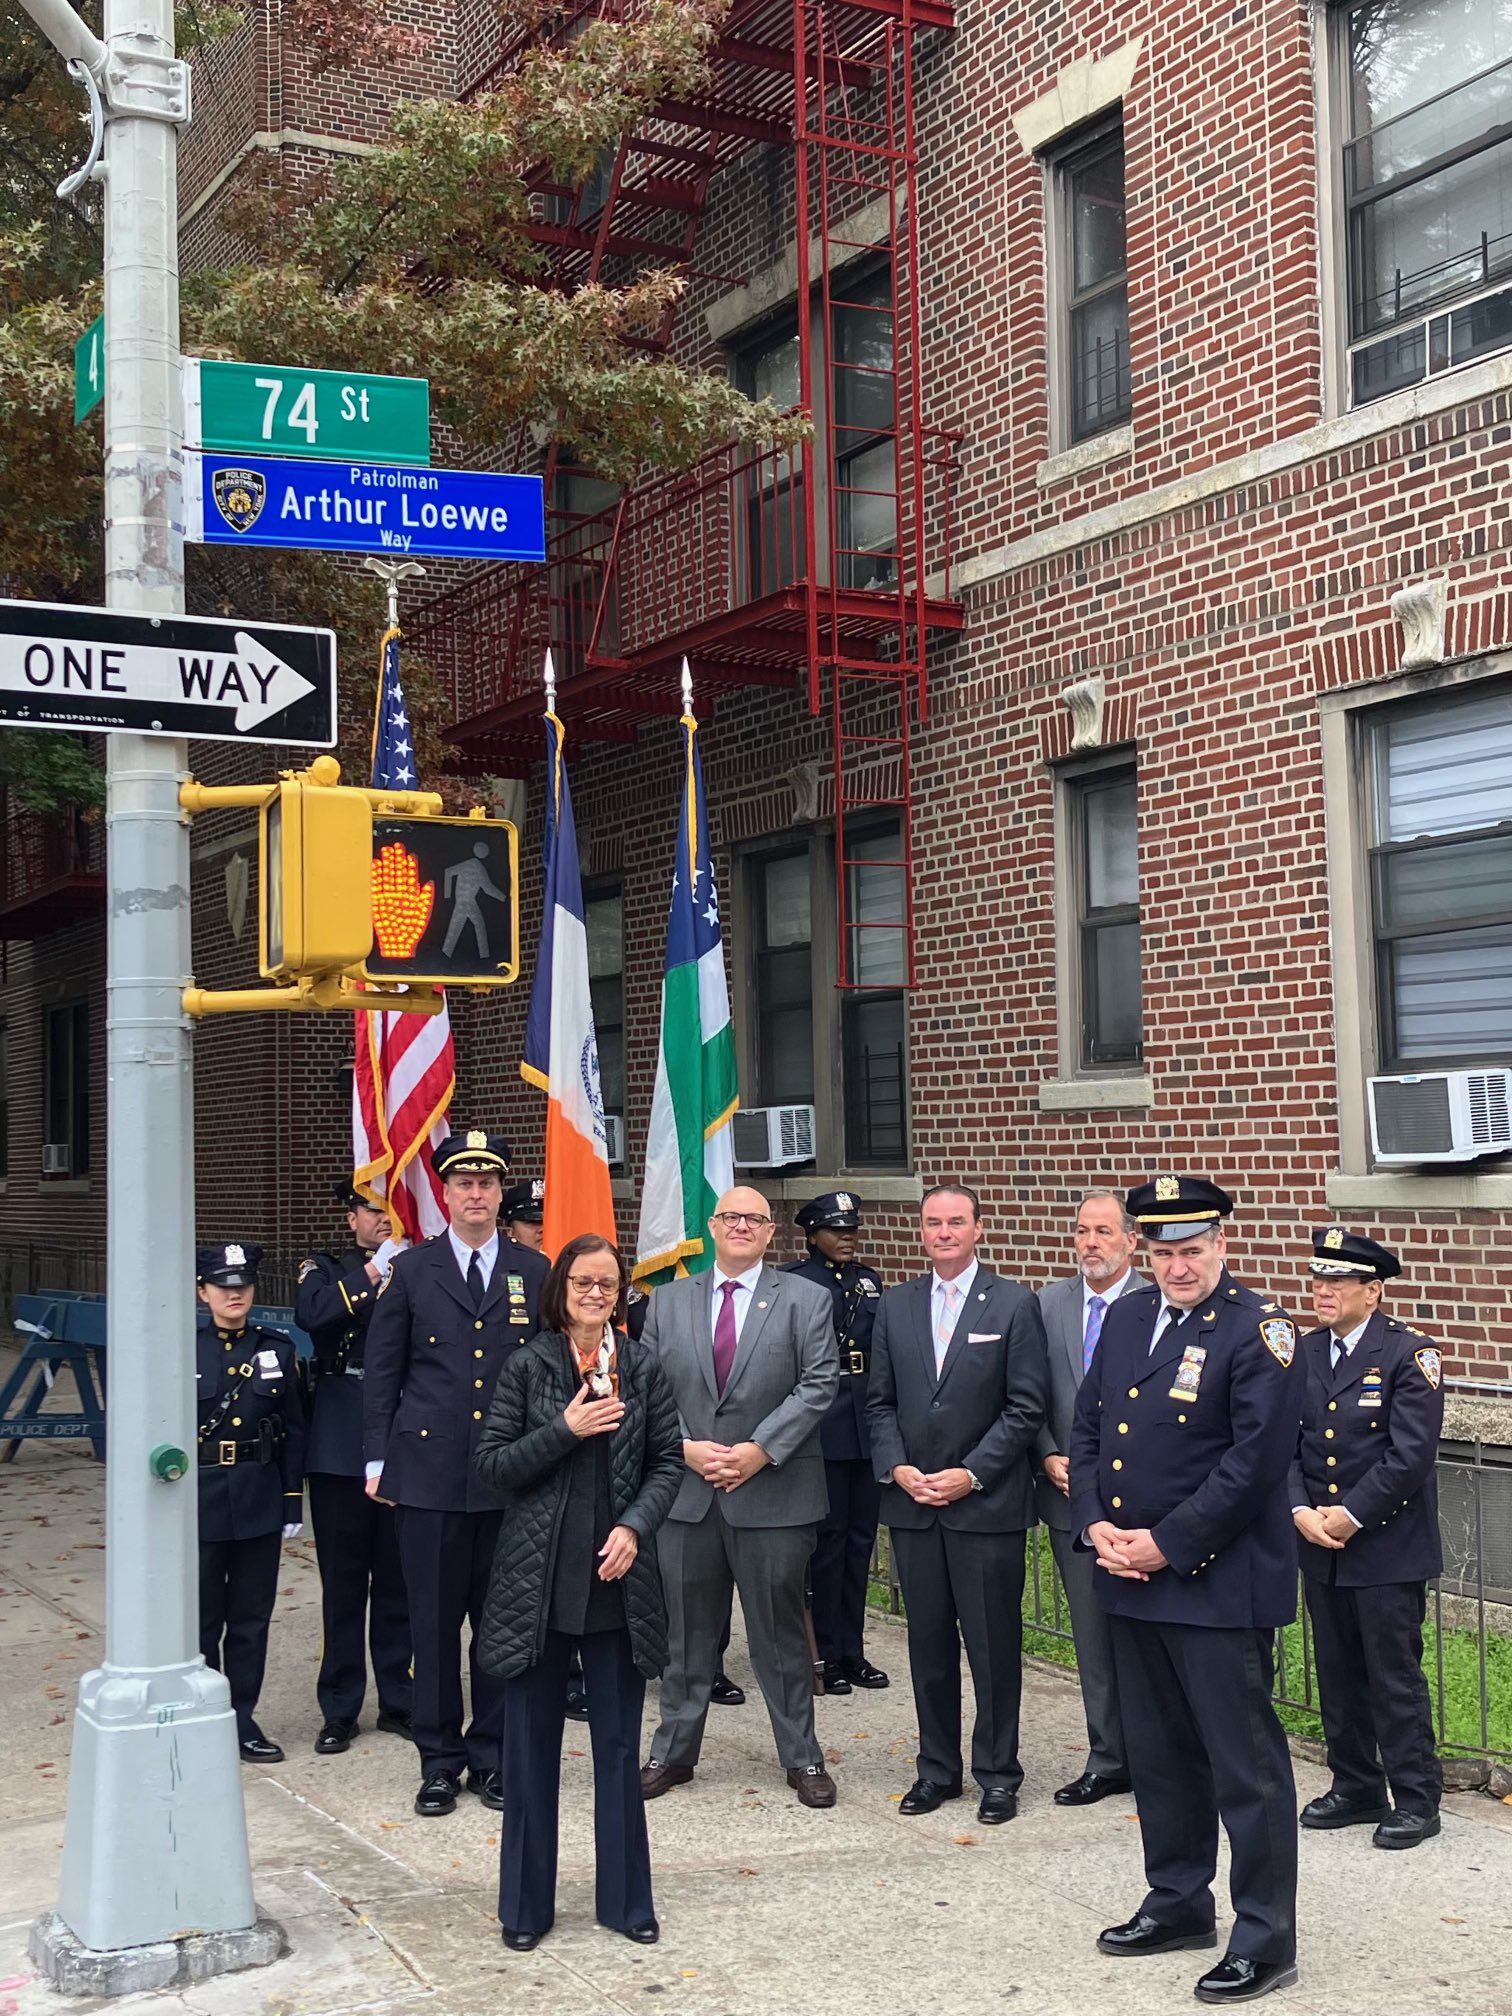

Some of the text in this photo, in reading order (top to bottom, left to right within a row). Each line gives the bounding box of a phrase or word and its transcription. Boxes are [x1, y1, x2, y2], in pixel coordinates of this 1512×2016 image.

[254, 377, 370, 444] 74 St
[216, 479, 262, 491] DEPARTMENT
[225, 472, 252, 480] POLICE
[350, 467, 439, 491] Patrolman
[280, 486, 508, 532] Arthur Loewe
[380, 528, 412, 551] Way
[24, 643, 280, 704] ONE WAY
[40, 712, 124, 723] TRANSPORTATION
[0, 1423, 90, 1436] POLICE DEPT
